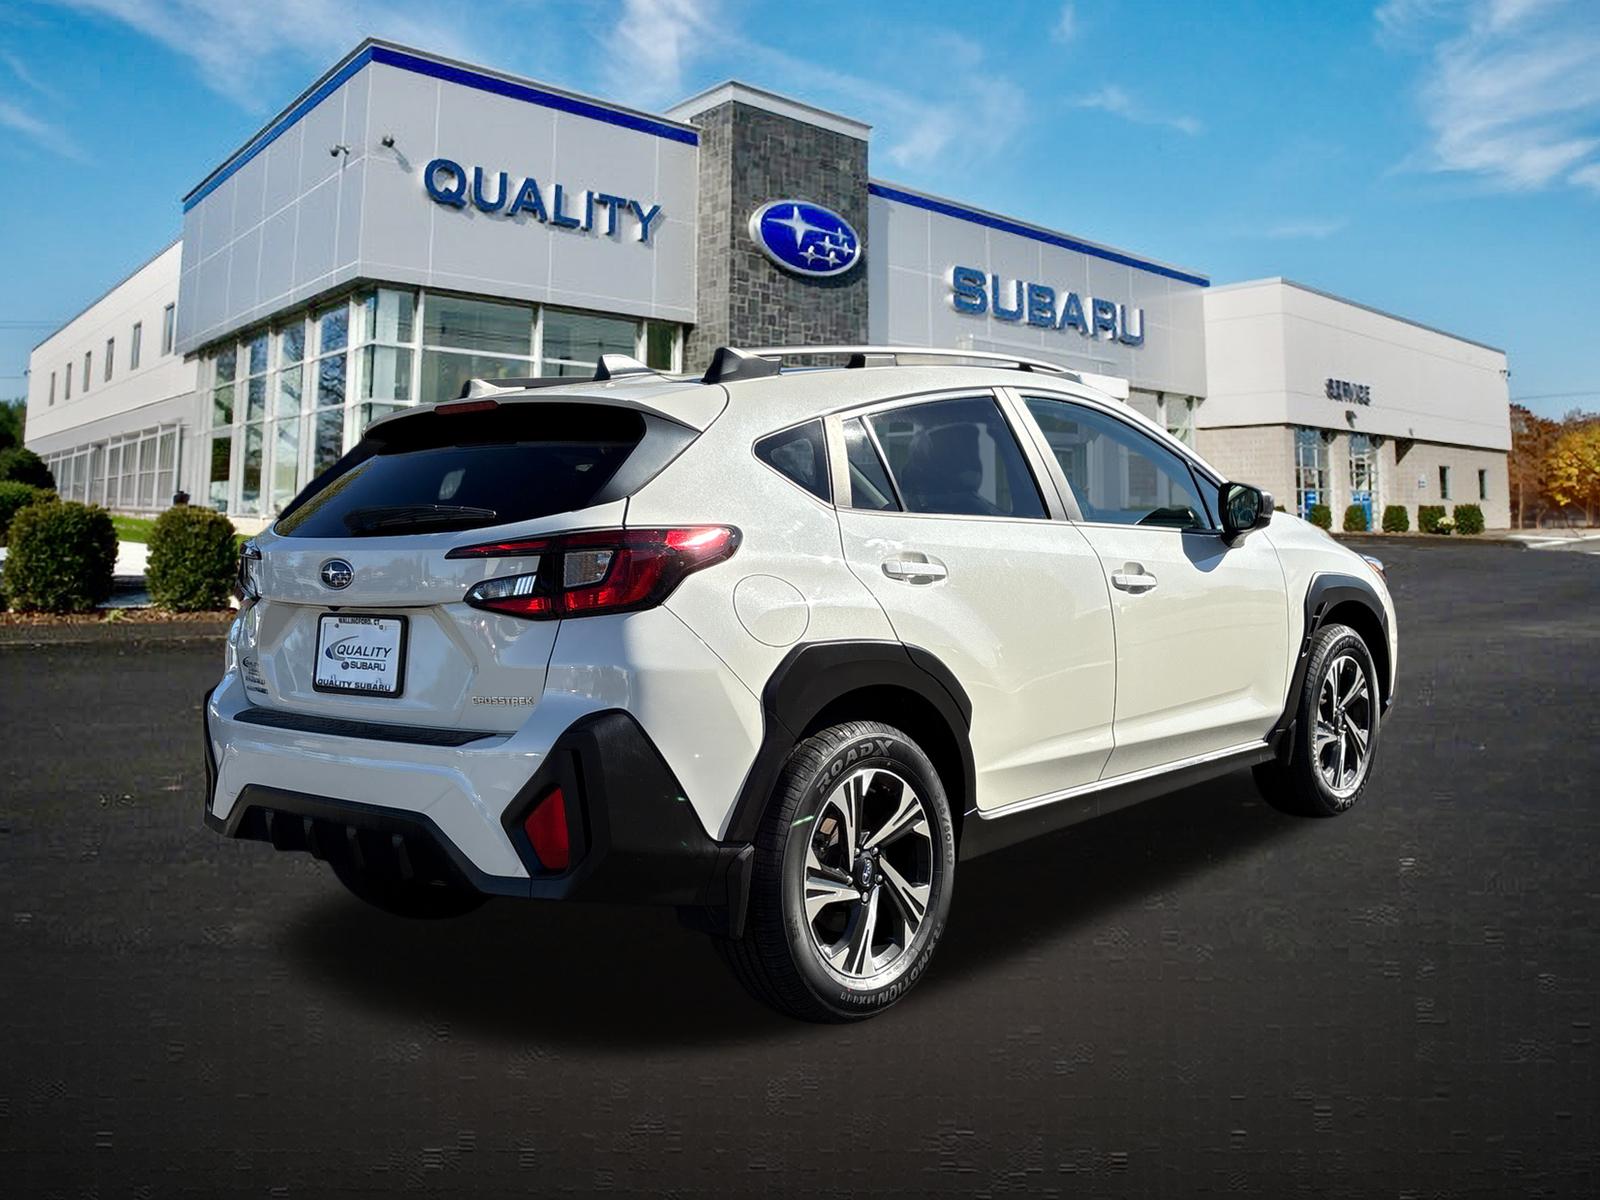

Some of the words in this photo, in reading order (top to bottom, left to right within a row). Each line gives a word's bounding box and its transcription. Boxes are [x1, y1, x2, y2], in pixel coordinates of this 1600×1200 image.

[424, 158, 661, 243] QUALITY
[950, 265, 1145, 347] SUBARU
[1324, 378, 1370, 407] SERVICE
[336, 644, 392, 658] QUALITY
[350, 661, 386, 672] SUBARU
[317, 678, 352, 689] QUALITY
[354, 681, 391, 692] SUBARU
[471, 696, 536, 707] CROSSTREK
[816, 739, 894, 794] ROADX
